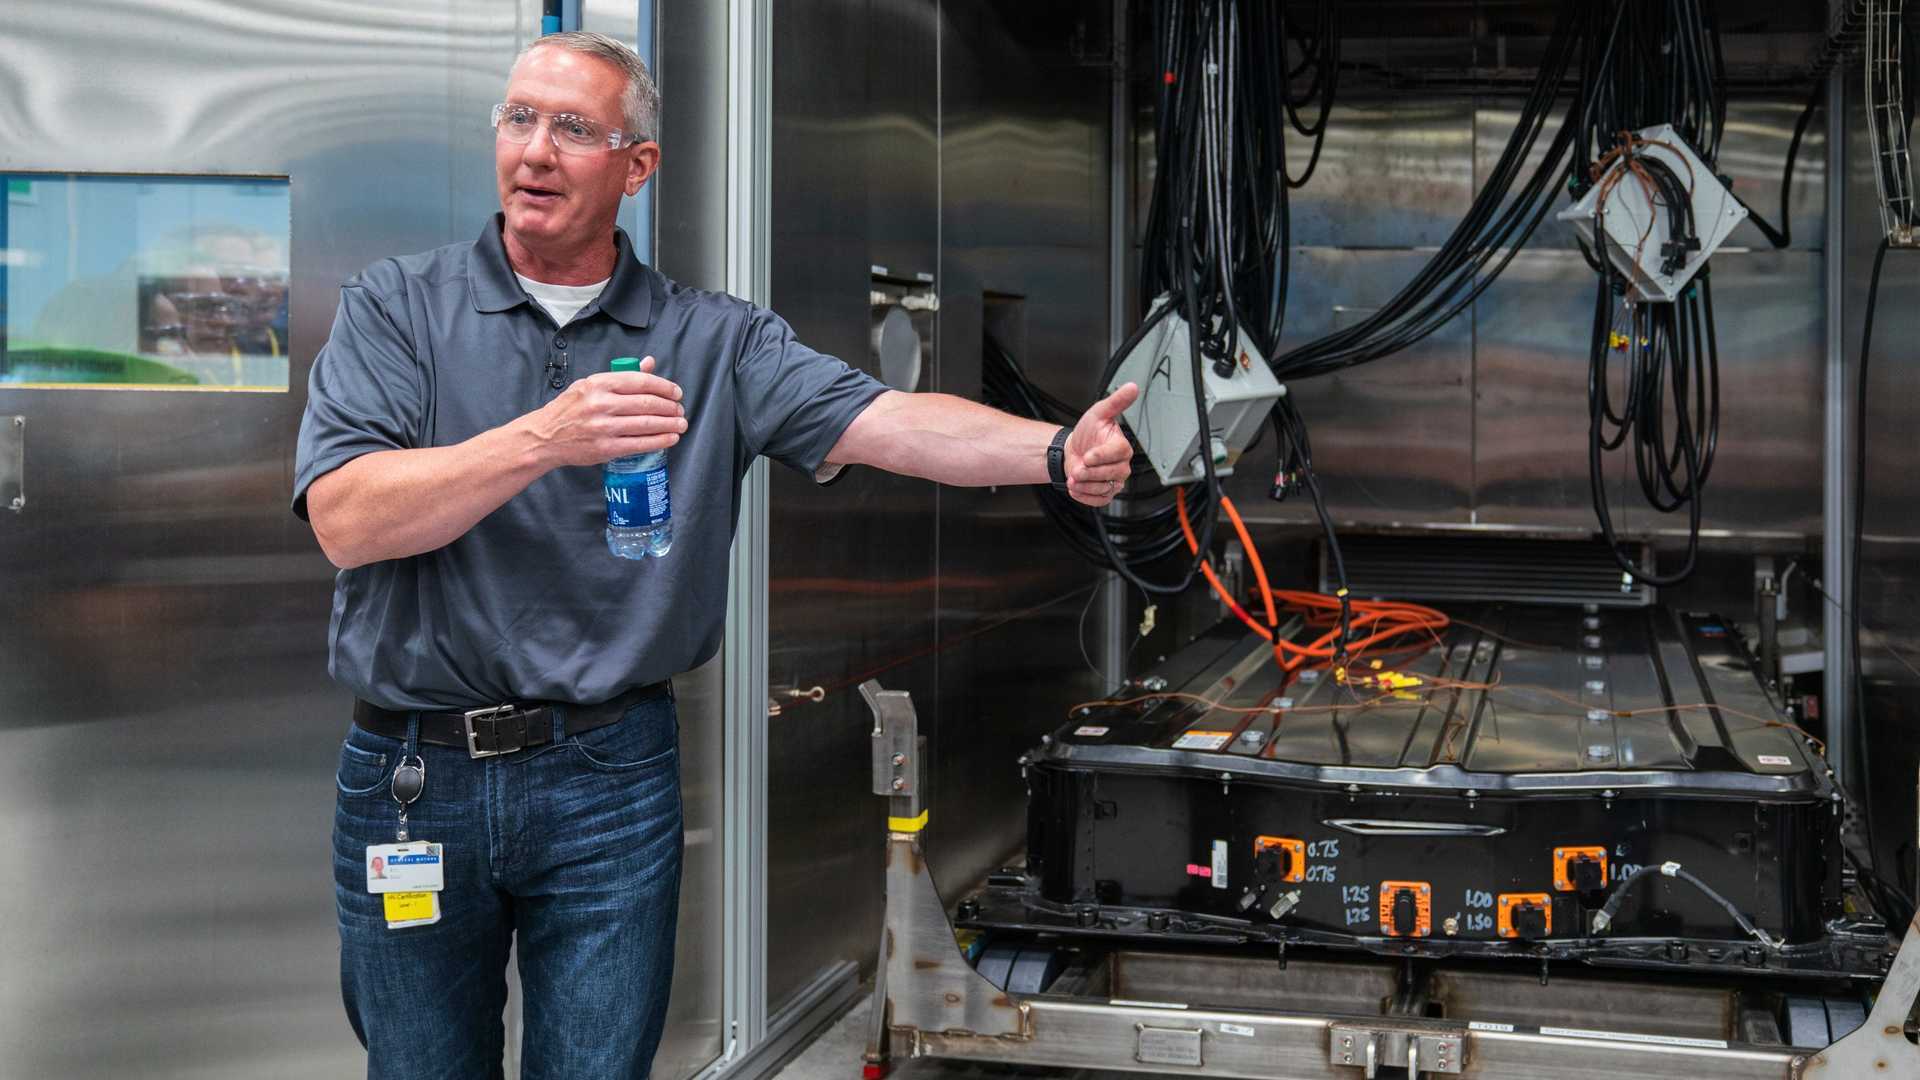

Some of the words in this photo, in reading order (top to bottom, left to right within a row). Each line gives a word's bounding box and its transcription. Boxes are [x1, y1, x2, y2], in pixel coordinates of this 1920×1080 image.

[1151, 354, 1172, 392] A
[1307, 839, 1340, 858] 0.75
[1342, 885, 1370, 904] 1.25
[1465, 888, 1493, 908] 1.00
[1467, 912, 1492, 930] 1.50
